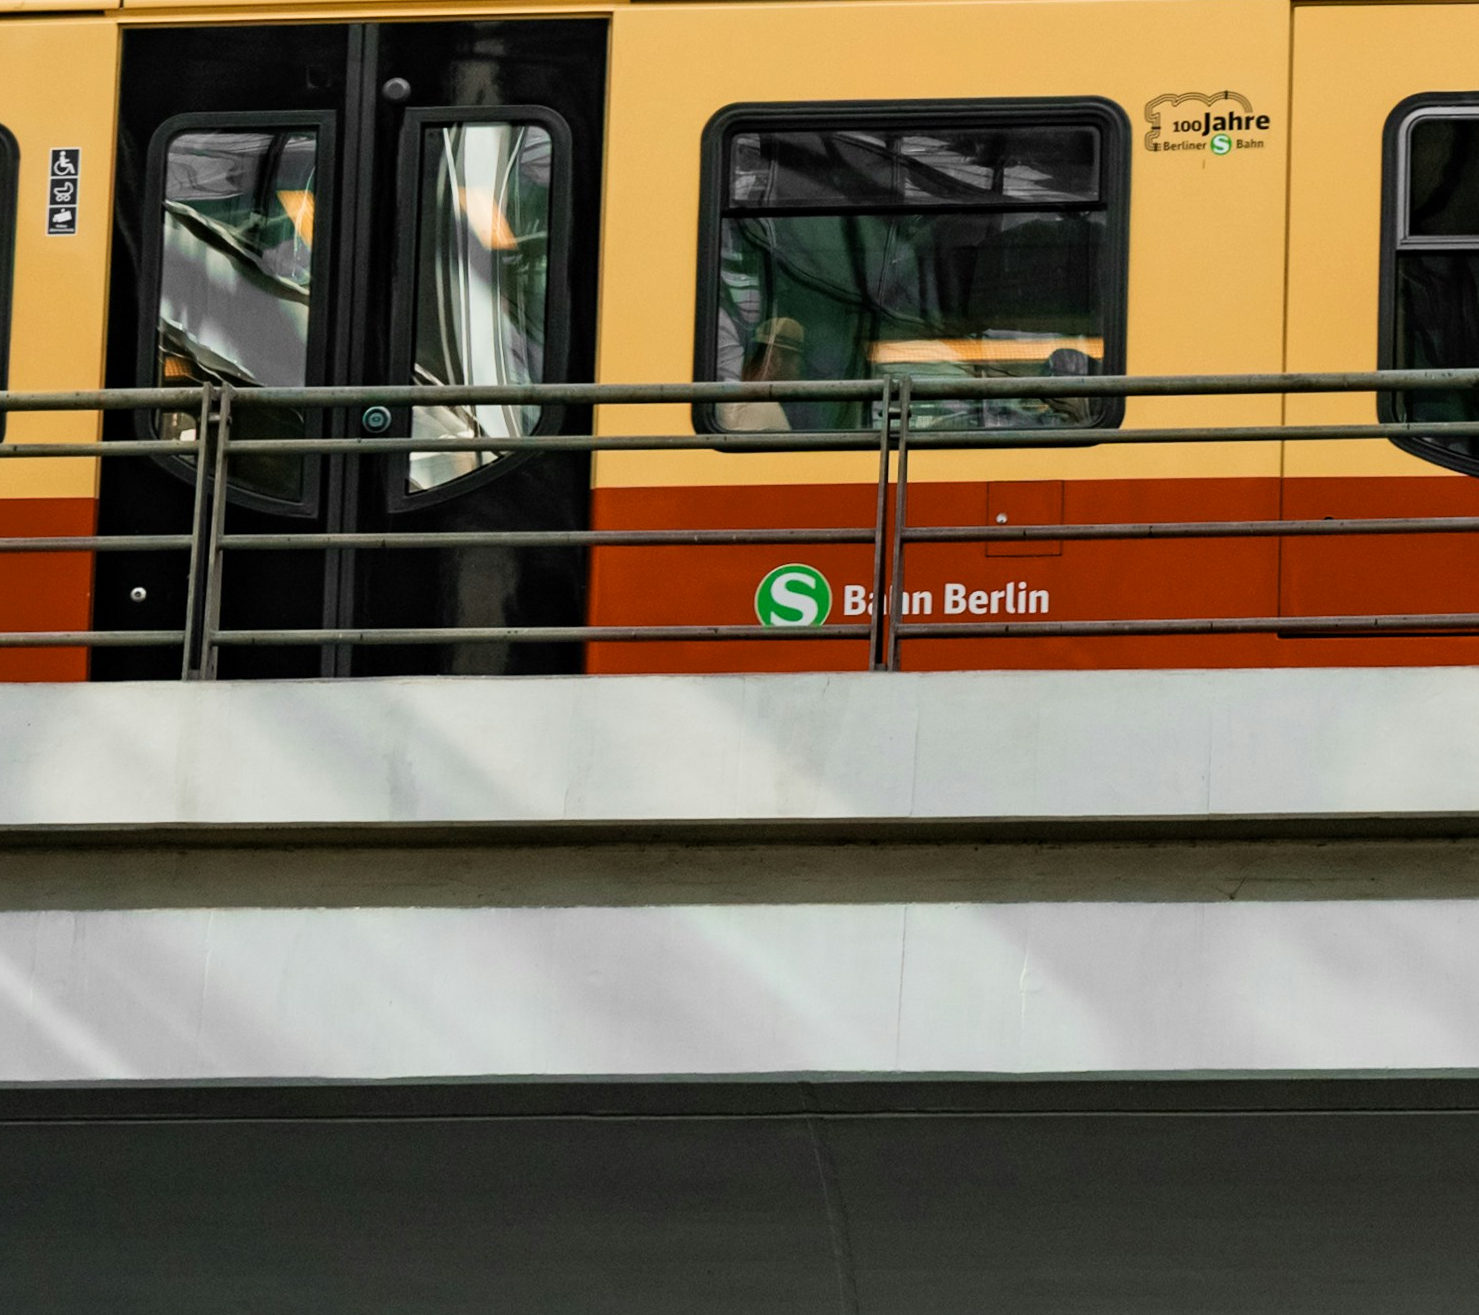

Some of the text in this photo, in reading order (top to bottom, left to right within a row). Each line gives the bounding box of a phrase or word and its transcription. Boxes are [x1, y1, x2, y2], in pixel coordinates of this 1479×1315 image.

[1173, 111, 1270, 136] 100 Jahre
[1163, 133, 1264, 154] Berliner S Bahn
[769, 571, 820, 626] S
[943, 581, 1050, 614] Berlin
